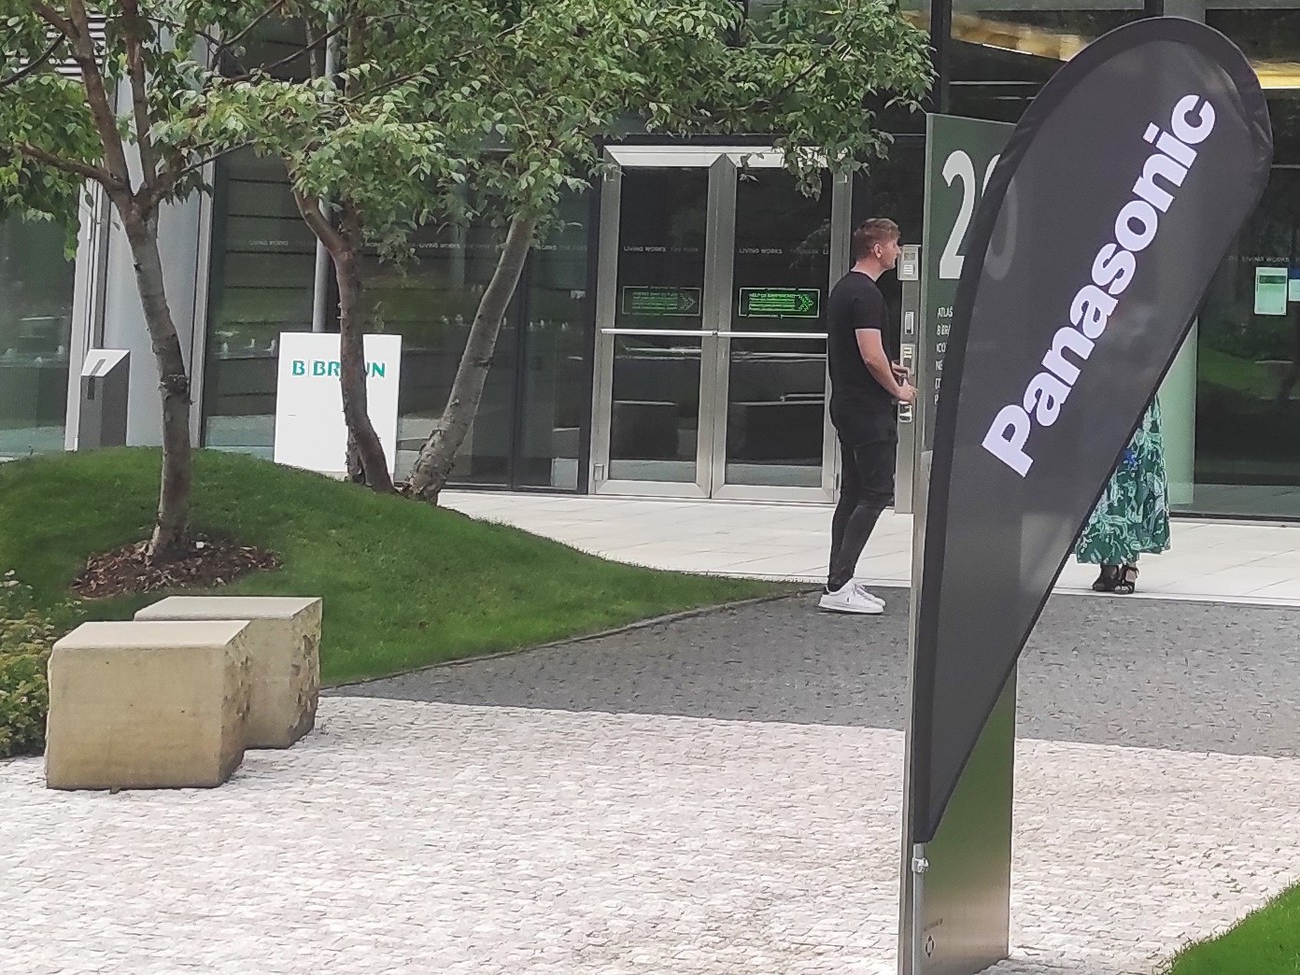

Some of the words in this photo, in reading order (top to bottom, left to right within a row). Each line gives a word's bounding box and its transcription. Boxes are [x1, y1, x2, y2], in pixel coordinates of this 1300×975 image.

[291, 360, 306, 377] B
[312, 360, 386, 378] BRN
[981, 93, 1217, 479] Panasonic
